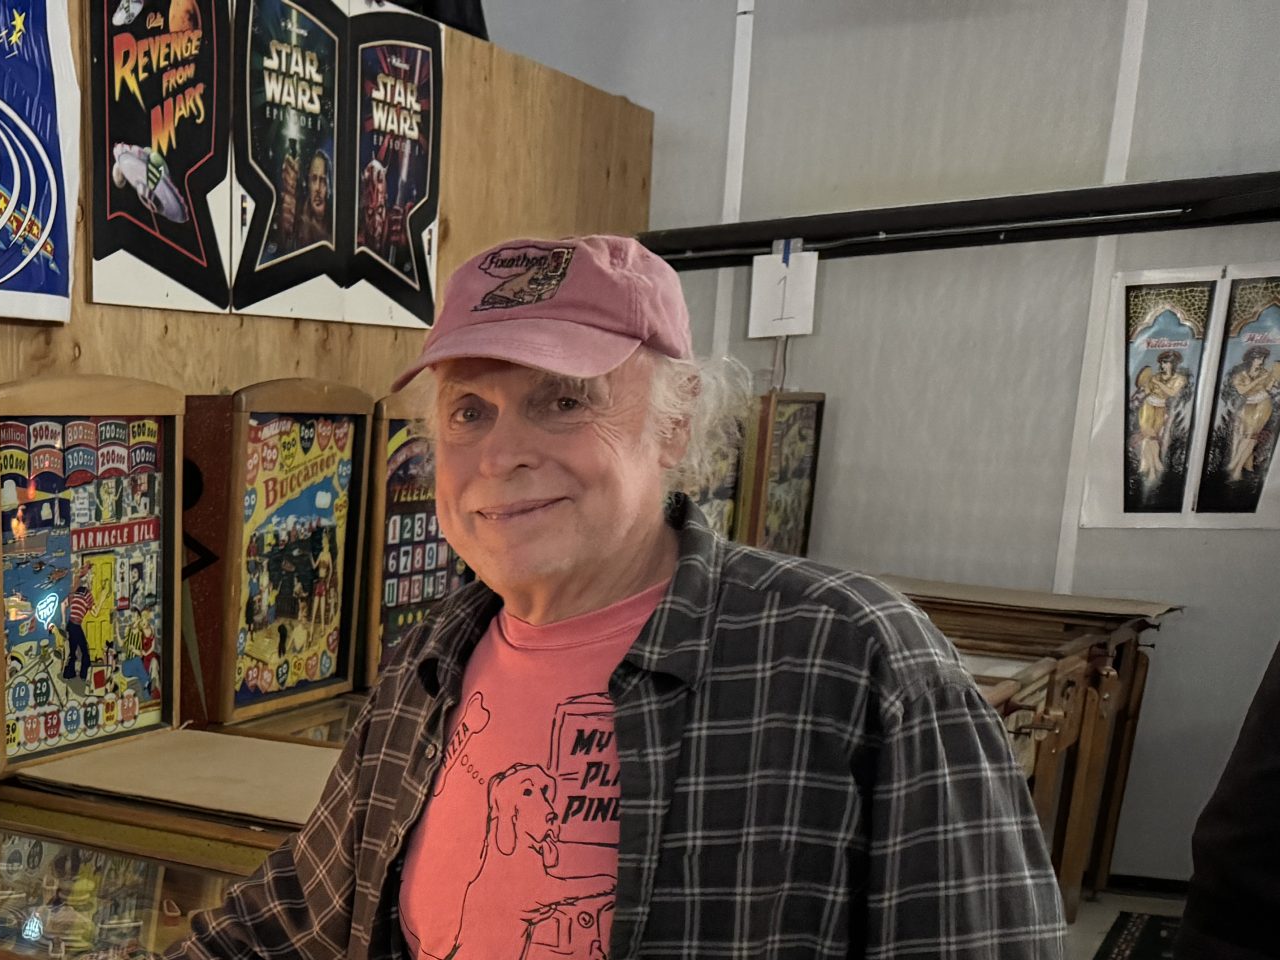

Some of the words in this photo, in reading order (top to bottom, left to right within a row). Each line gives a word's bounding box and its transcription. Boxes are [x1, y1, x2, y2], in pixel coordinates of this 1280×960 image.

[113, 28, 202, 111] REVENGE
[162, 64, 195, 94] FROM
[263, 40, 324, 83] STAR
[263, 73, 324, 115] WARS
[372, 74, 421, 110] STAR
[151, 83, 206, 156] MARS
[372, 102, 421, 141] WARS
[772, 275, 796, 322] 1
[73, 527, 129, 552] BARNACLE
[134, 523, 155, 541] BILL
[403, 518, 412, 539] 2
[416, 517, 424, 538] 3
[388, 551, 397, 573] 6
[402, 549, 411, 571] 7
[415, 547, 423, 569] 8
[427, 546, 435, 567] 9
[441, 722, 470, 770] PIZZA
[570, 728, 613, 756] MY
